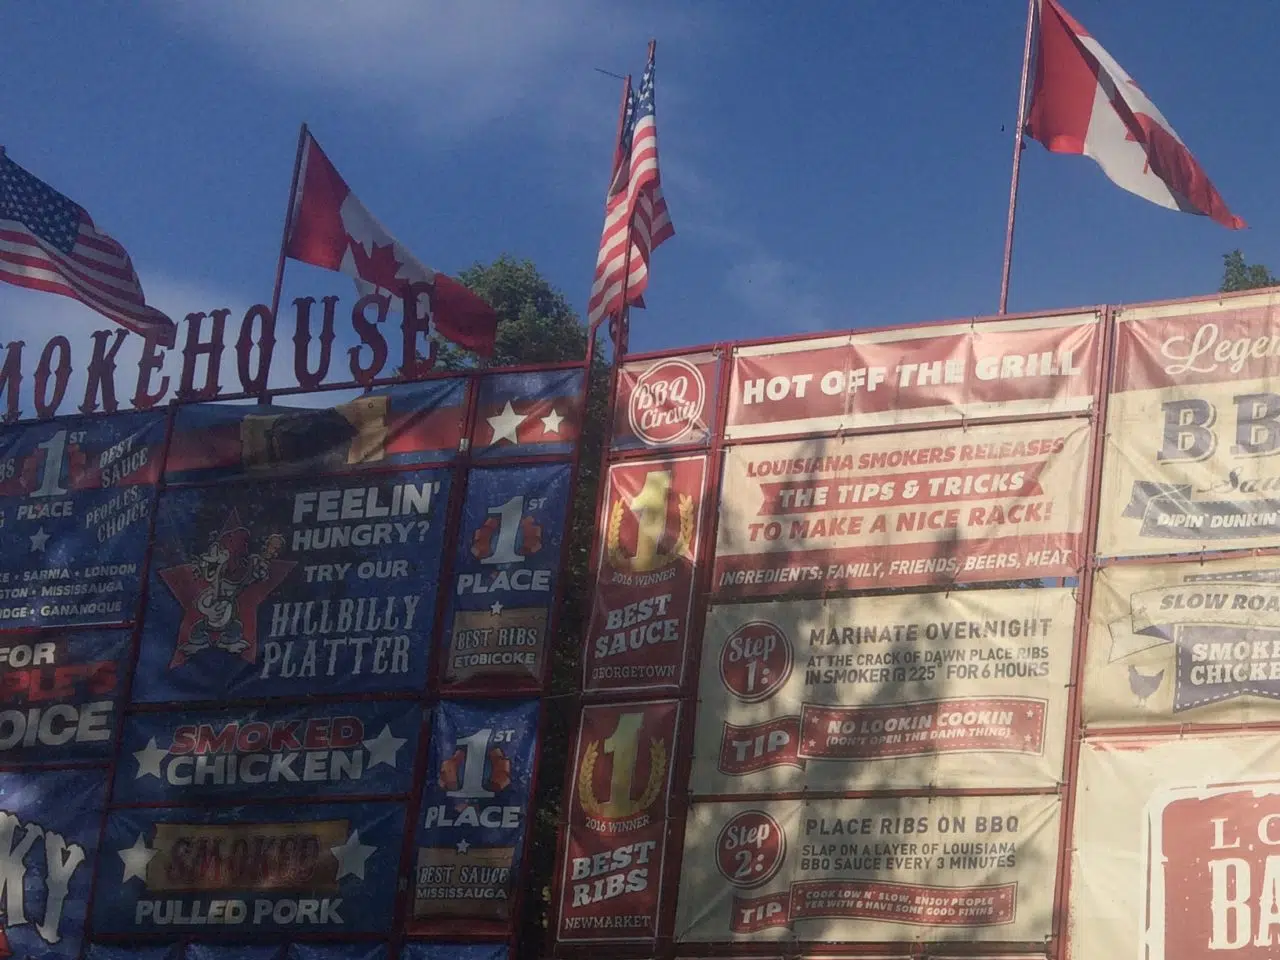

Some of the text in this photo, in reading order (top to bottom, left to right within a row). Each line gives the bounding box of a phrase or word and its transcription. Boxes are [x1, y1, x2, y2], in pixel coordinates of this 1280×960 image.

[742, 350, 1081, 404] HOT OFF THE GRILL
[746, 437, 1065, 478] LOUISIANA SMOKERS RELEASES
[292, 482, 440, 524] FEELIN'
[778, 471, 1026, 508] THE TIPS & TRICKS
[292, 521, 430, 551] HUNGRY?
[748, 502, 1053, 542] TO MAKE A NICE RACK!
[23, 564, 136, 581] SARNIA LONDON
[304, 558, 408, 583] TRY OUR
[456, 569, 550, 594] PLACE
[719, 550, 1072, 586] INGREDIENTS: FAMILY, FRIENDS, BEERS, MEAT
[41, 581, 124, 596] MISSISSAUGA
[269, 594, 419, 639] HILLBILLY
[458, 628, 538, 650] BEST RIBS
[809, 618, 1052, 646] MARINATE OVERNIGHT
[260, 635, 410, 681] PLATTER
[454, 650, 535, 668] ETOBICOKE
[168, 716, 364, 756] SMOKED
[827, 711, 1013, 734] NO LOOKIN COOKIN
[732, 731, 790, 761] TIP
[165, 748, 364, 786] CHICKEN
[805, 816, 1019, 836] PLACE RIBS ON BBQ
[801, 855, 1016, 871] BBQ SAUCE EVERY 3 MINUTES
[135, 898, 344, 925] PULLED PORK
